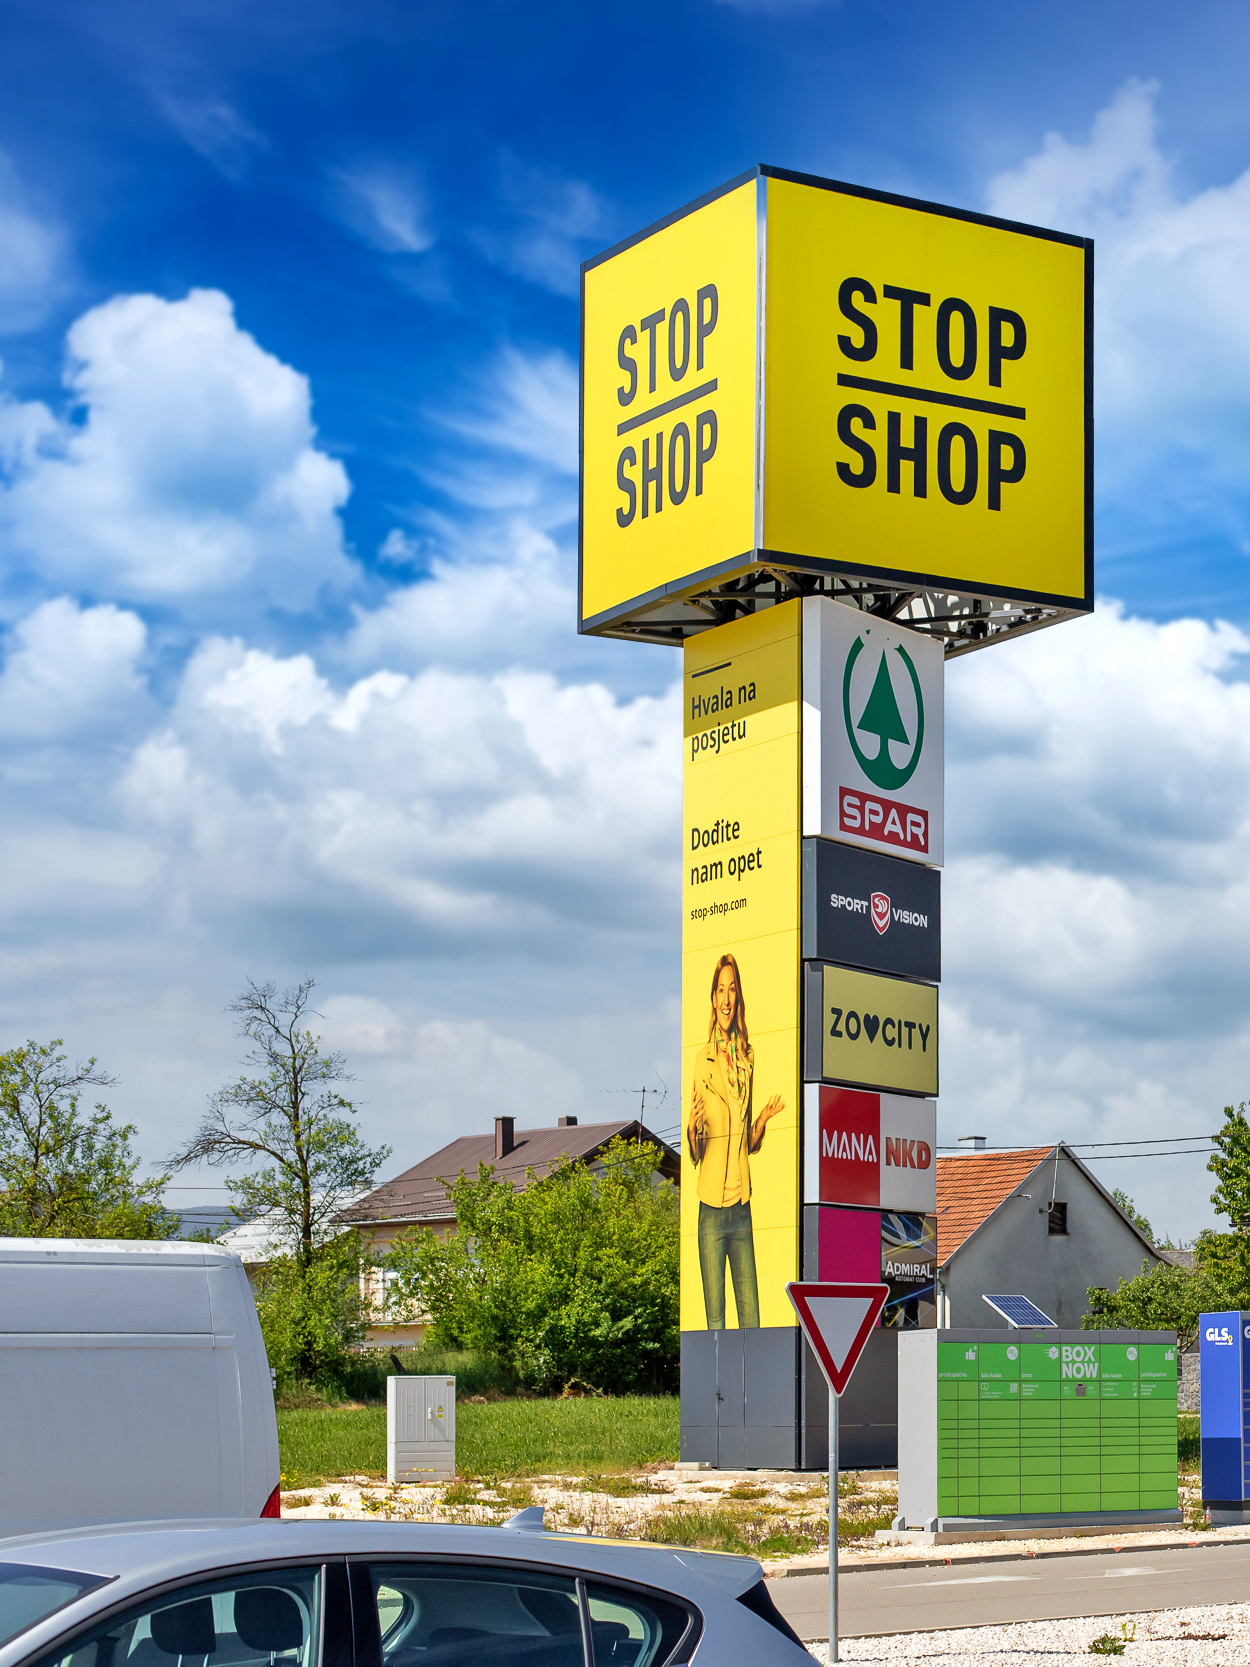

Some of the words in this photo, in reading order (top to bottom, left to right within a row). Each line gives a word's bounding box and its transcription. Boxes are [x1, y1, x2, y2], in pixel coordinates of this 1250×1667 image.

[617, 283, 719, 407] STOP
[837, 277, 1027, 388] STOP
[616, 409, 718, 528] SHOP
[835, 403, 1027, 511] SHOP
[691, 685, 733, 720] Hvala
[738, 681, 756, 705] na
[691, 720, 746, 762] posjetu
[691, 818, 740, 851] Dođite
[842, 794, 926, 846] SPAR
[690, 860, 723, 886] nam
[728, 847, 763, 882] opet
[690, 897, 747, 921] stop-shop.com
[830, 893, 869, 915] SPORT
[892, 907, 928, 928] VISION
[822, 1128, 878, 1164] MANA
[885, 1135, 932, 1171] NKD
[885, 1260, 933, 1278] ADMIRAL
[1062, 1345, 1096, 1362] BOX
[1062, 1362, 1098, 1379] NOW
